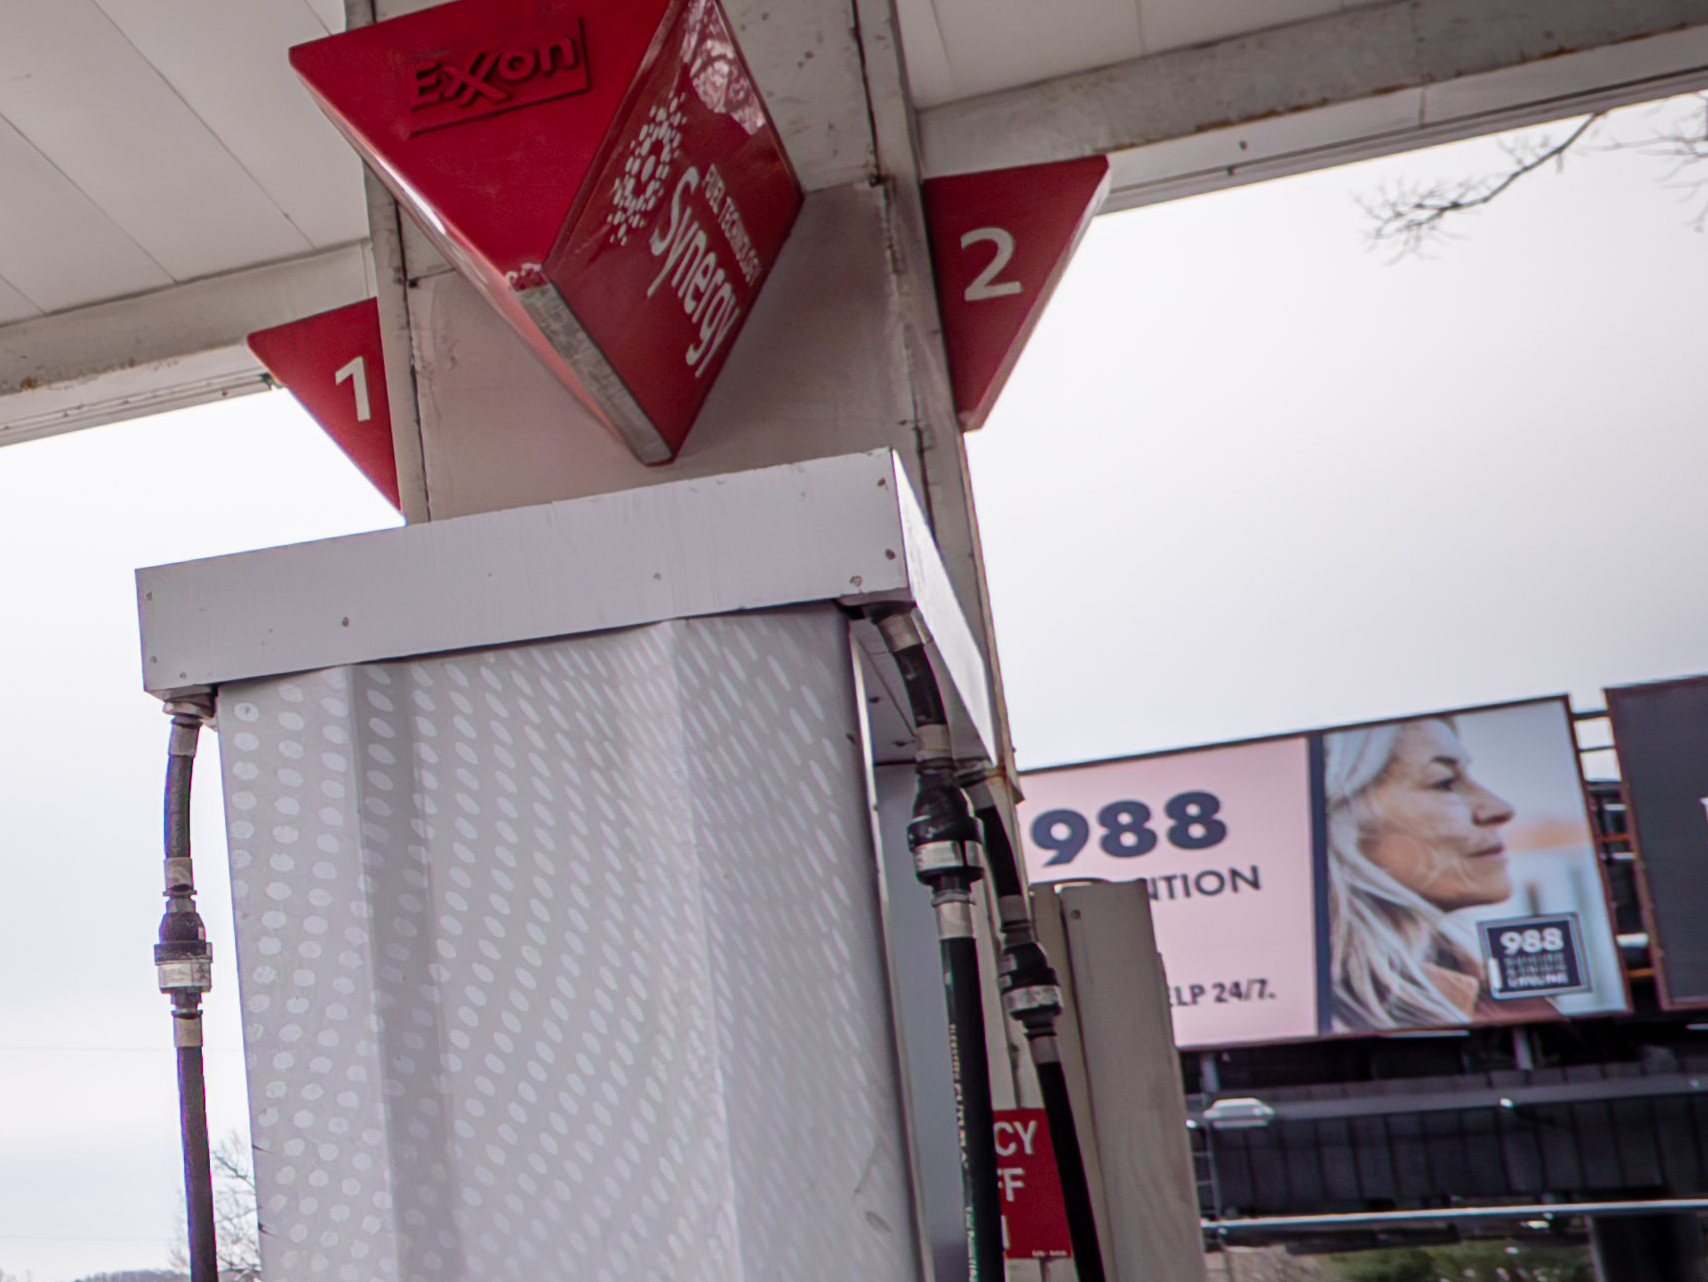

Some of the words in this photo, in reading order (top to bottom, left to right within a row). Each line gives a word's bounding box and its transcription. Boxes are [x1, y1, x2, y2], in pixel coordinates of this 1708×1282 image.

[409, 37, 579, 110] Exxon
[647, 166, 740, 378] Synergy
[960, 227, 1023, 302] 2
[334, 355, 371, 422] 1
[1030, 789, 1228, 867] 988
[1500, 927, 1564, 956] 988
